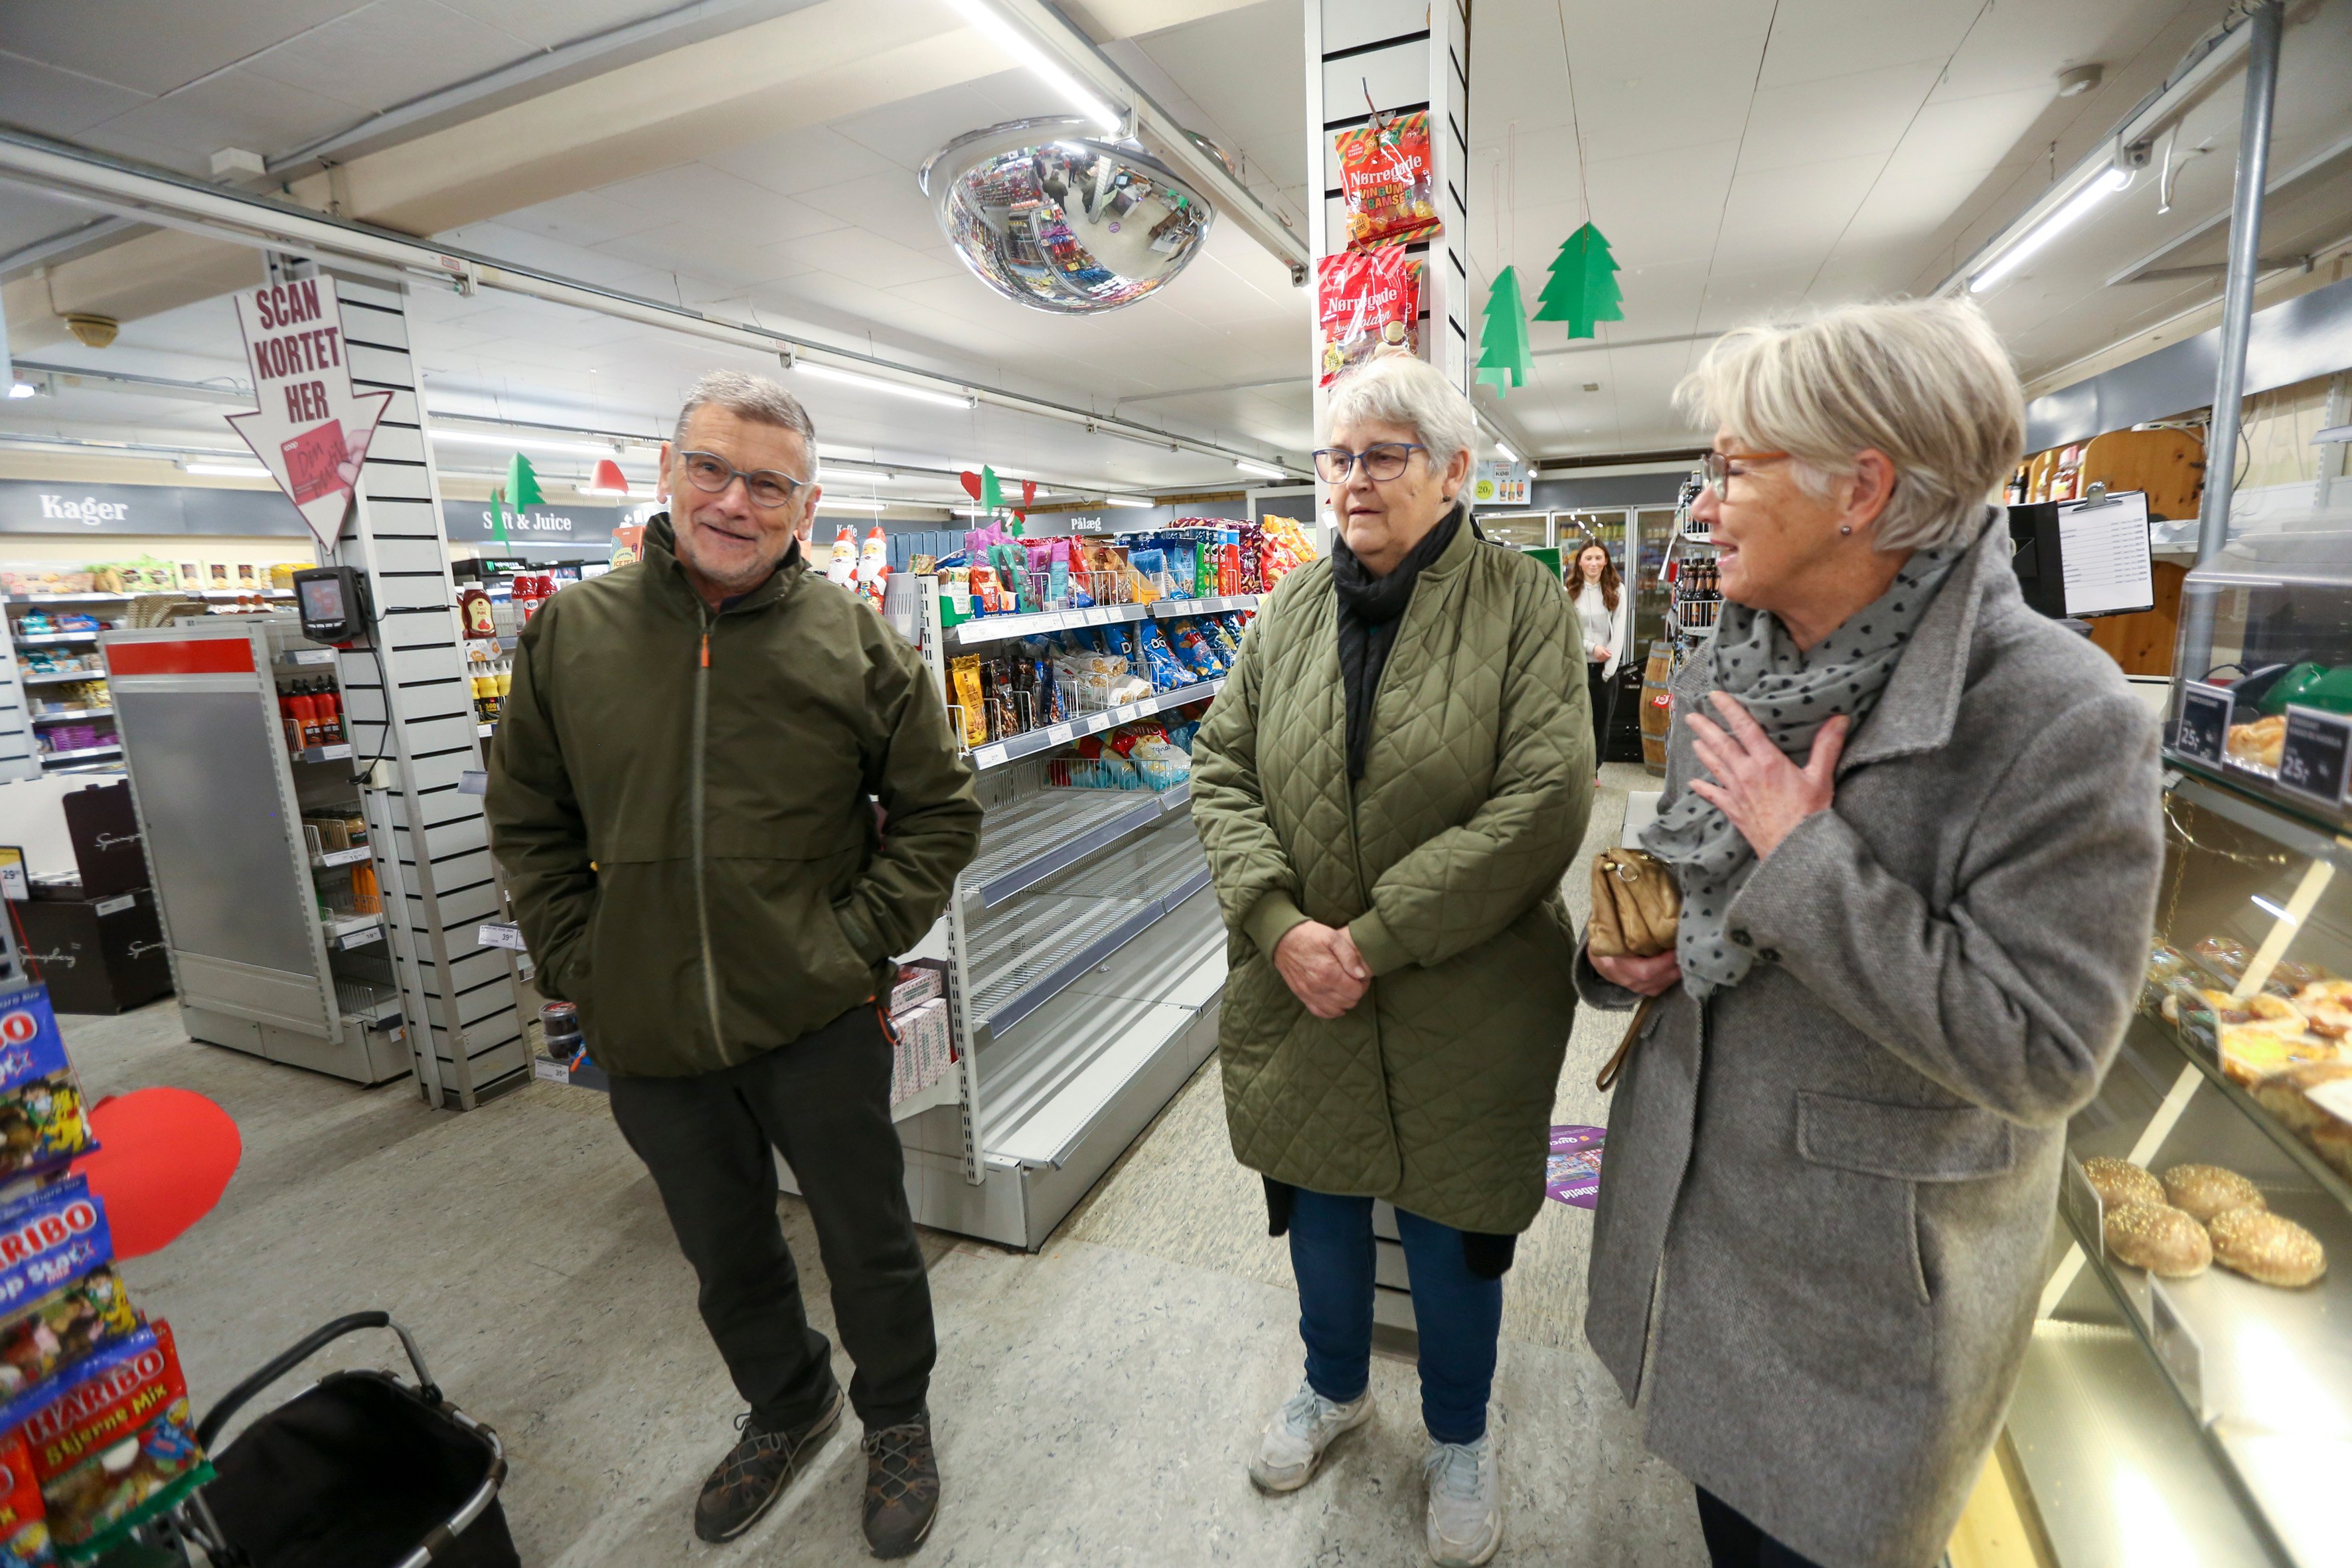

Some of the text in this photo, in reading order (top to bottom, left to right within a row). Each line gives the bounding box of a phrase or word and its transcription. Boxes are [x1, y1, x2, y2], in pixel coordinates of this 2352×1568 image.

[1350, 155, 1422, 188] Nørregade
[1368, 189, 1411, 210] BAMSER
[256, 279, 322, 330] SCAN
[1329, 287, 1397, 315] Nørrgade
[254, 327, 341, 380] KORTET
[284, 380, 330, 423] HER
[39, 494, 129, 526] Kager
[483, 510, 572, 531] Sft & Juice
[1071, 516, 1102, 532] Pålæg
[836, 524, 858, 538] Kffe
[1559, 1186, 1599, 1200] abetid
[24, 1347, 165, 1446] HARIBO
[45, 1383, 167, 1467] Stjerne Mix
